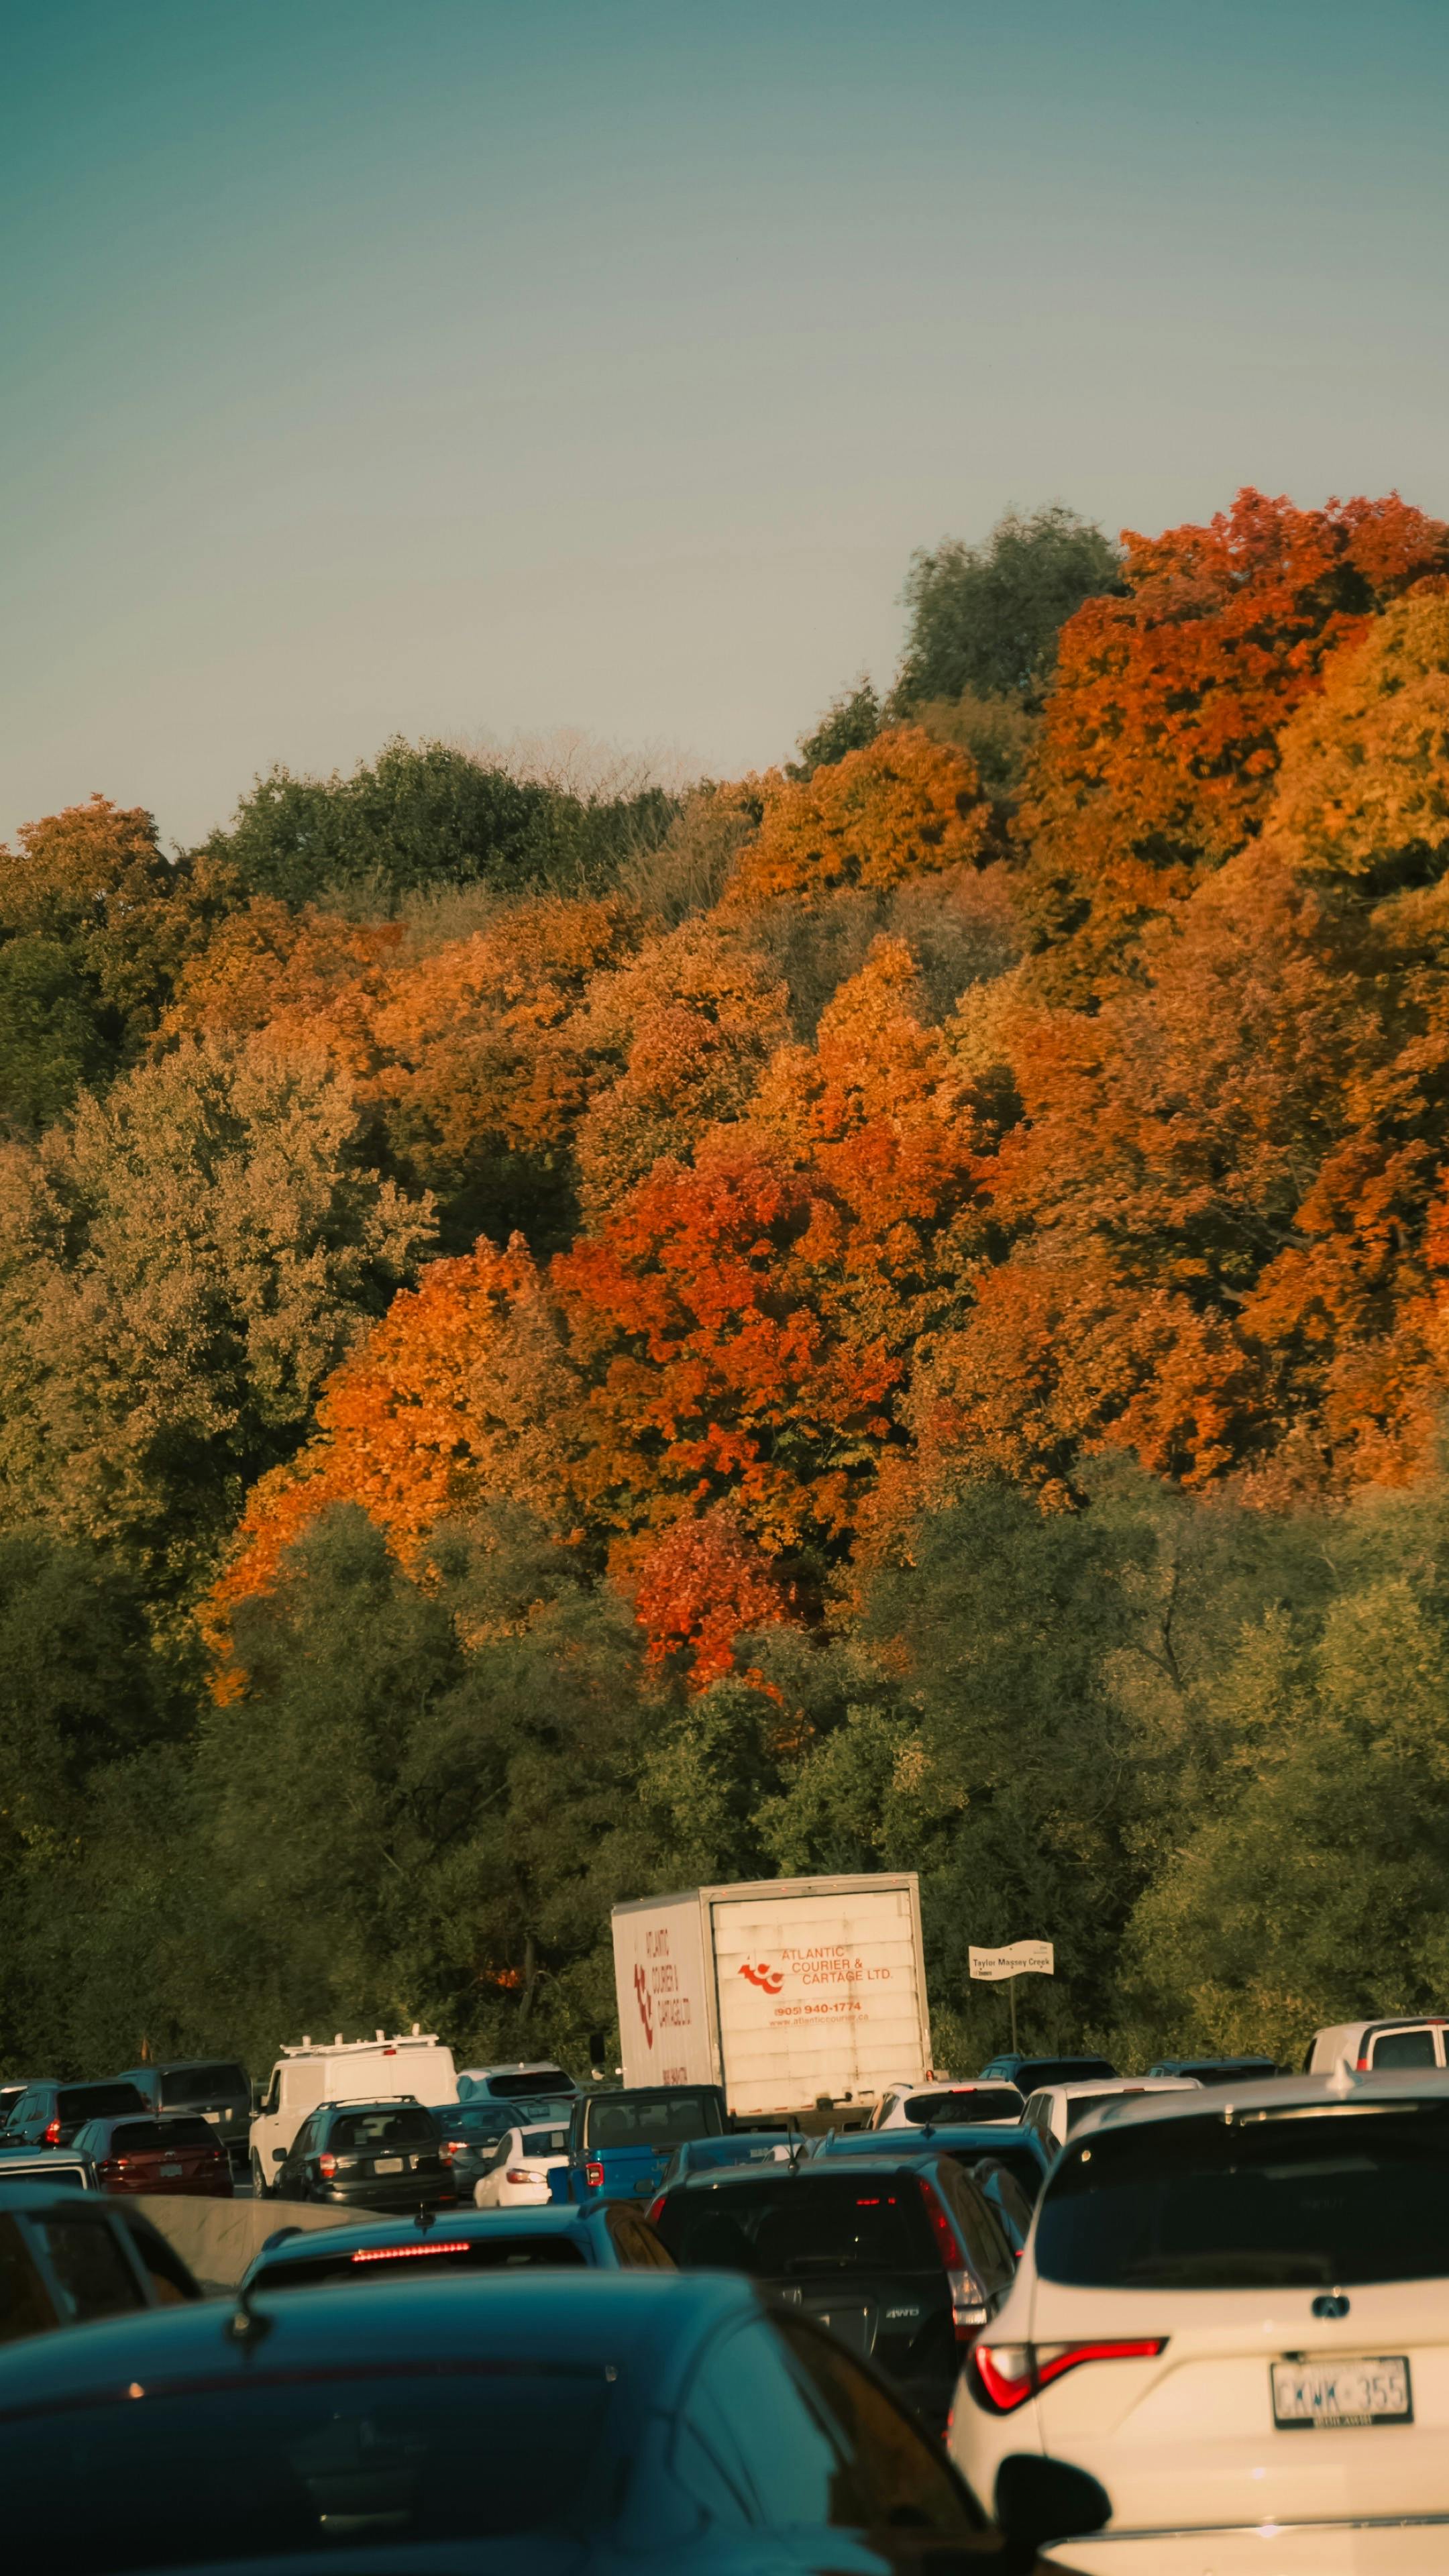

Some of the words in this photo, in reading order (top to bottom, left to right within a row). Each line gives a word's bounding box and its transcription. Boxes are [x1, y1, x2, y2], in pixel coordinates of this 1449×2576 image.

[782, 1946, 845, 1960] ATLANTIC
[792, 1959, 851, 1973] COURIER
[854, 1958, 863, 1969] &
[973, 1959, 996, 1968] Taylor
[998, 1957, 1027, 1968] Massey
[1028, 1957, 1050, 1966] Creek
[802, 1970, 863, 1985] CARTAGE
[867, 1968, 894, 1980] LTD.
[774, 2006, 802, 2017] (905)
[804, 2002, 861, 2014] 940-1774
